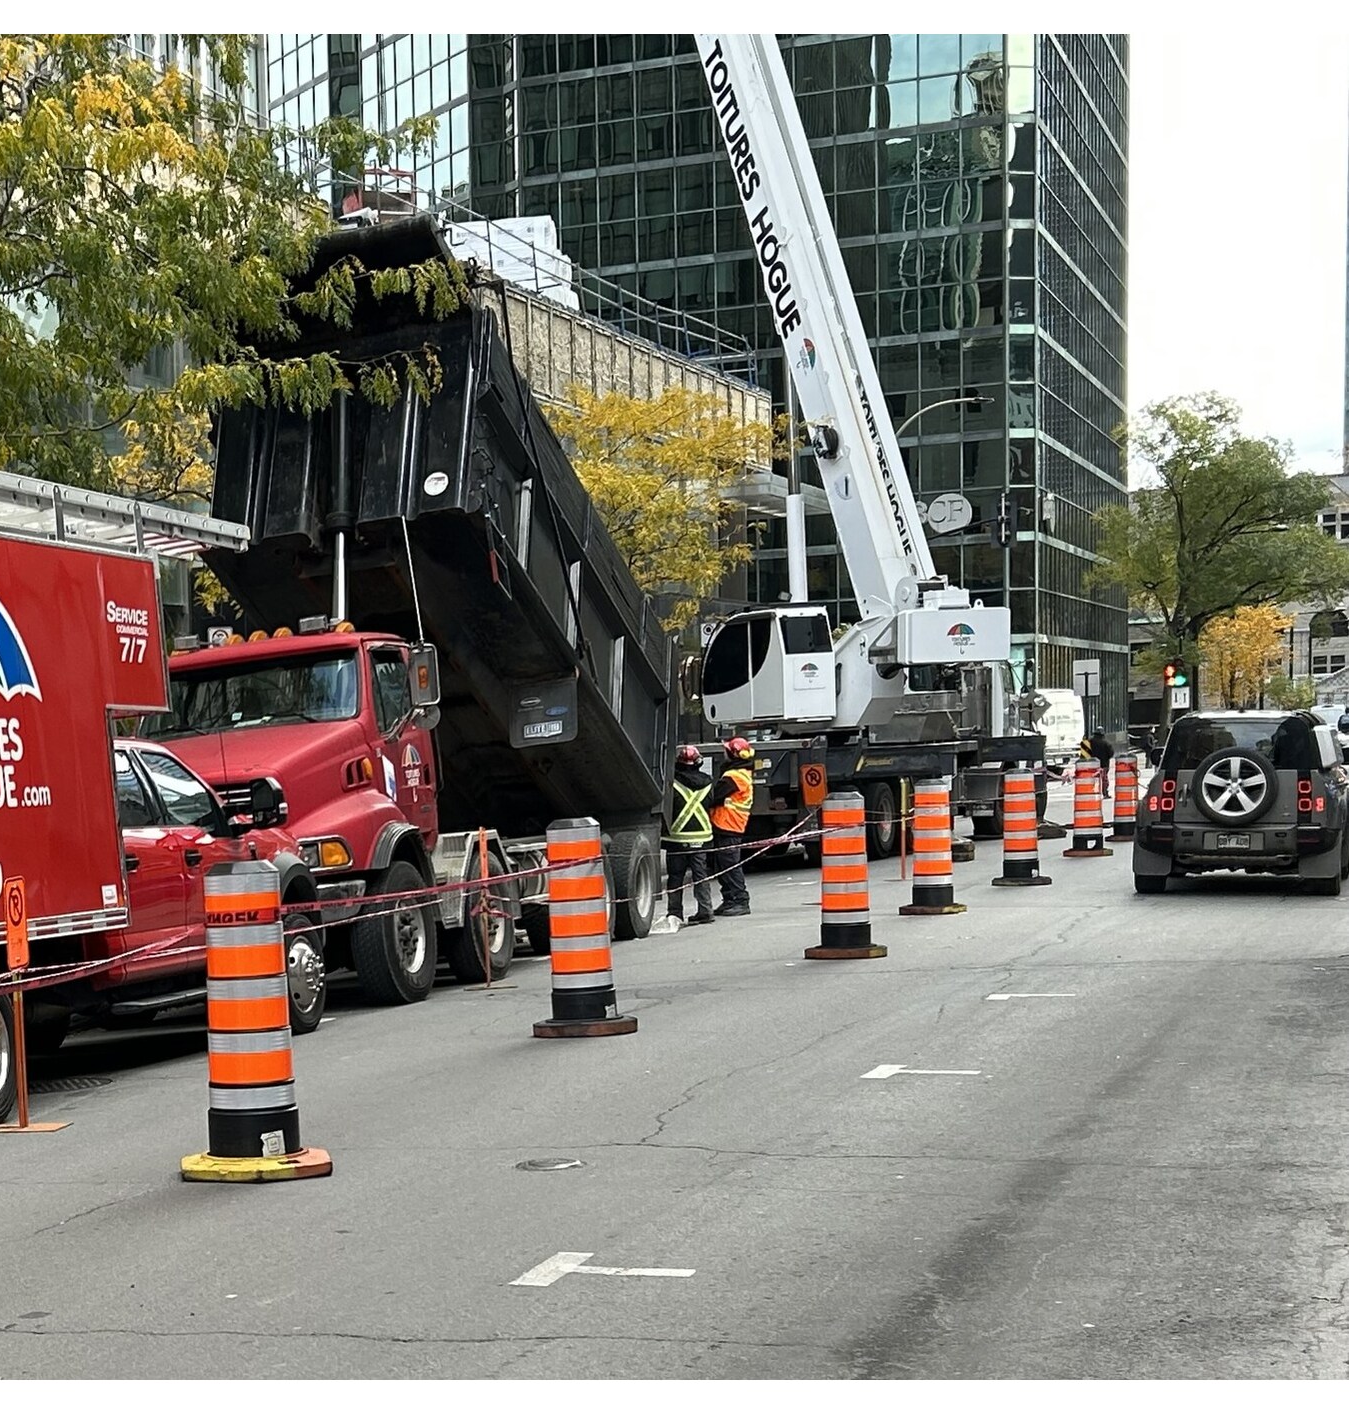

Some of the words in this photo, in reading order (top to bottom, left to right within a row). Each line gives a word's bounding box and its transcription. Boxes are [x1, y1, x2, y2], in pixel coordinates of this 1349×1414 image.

[705, 38, 760, 201] TOITURES
[752, 205, 801, 339] HOGUE
[106, 600, 149, 626] SERVICE
[119, 637, 147, 664] 7/7
[21, 785, 52, 807] .com
